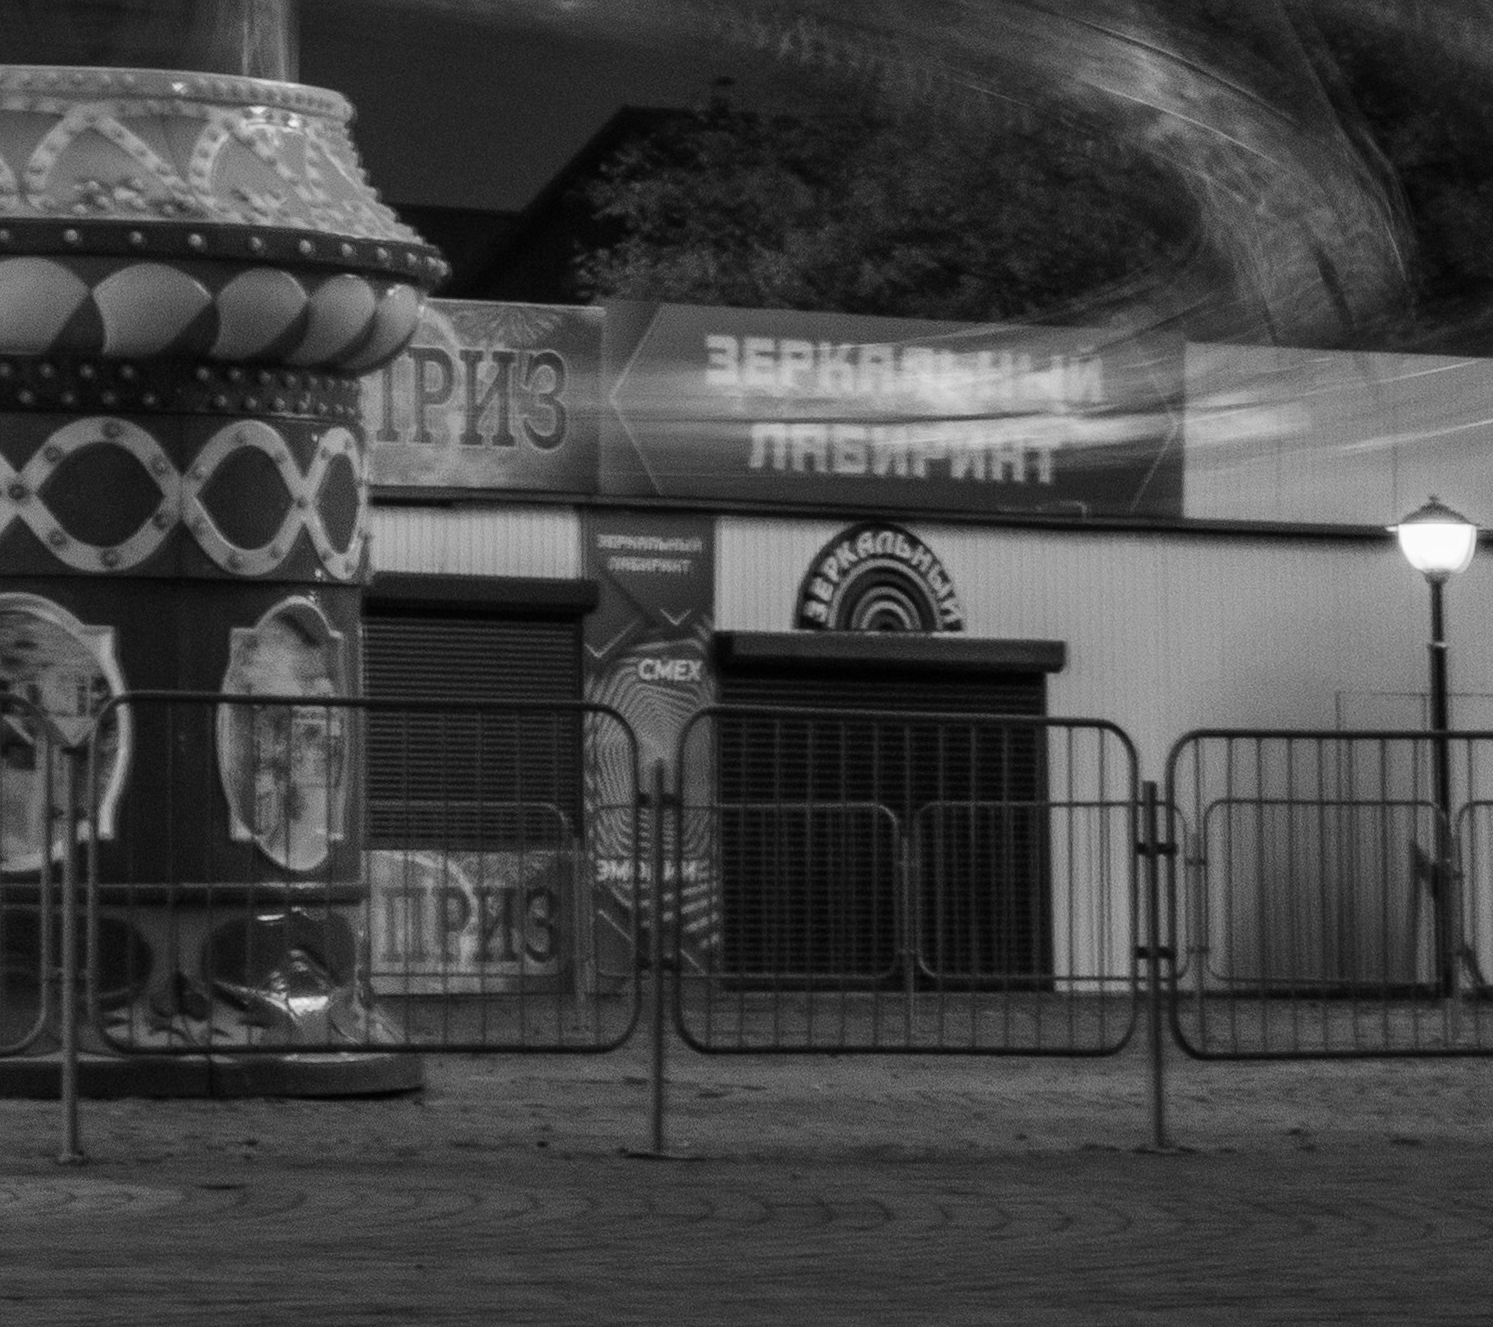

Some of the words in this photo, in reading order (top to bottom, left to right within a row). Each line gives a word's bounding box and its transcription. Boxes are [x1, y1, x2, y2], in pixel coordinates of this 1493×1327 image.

[748, 422, 1059, 485] ЛАБИРИНТ
[803, 530, 965, 623] ЗЕРКАЛЬНЫЙ
[637, 657, 703, 681] СМЕХ
